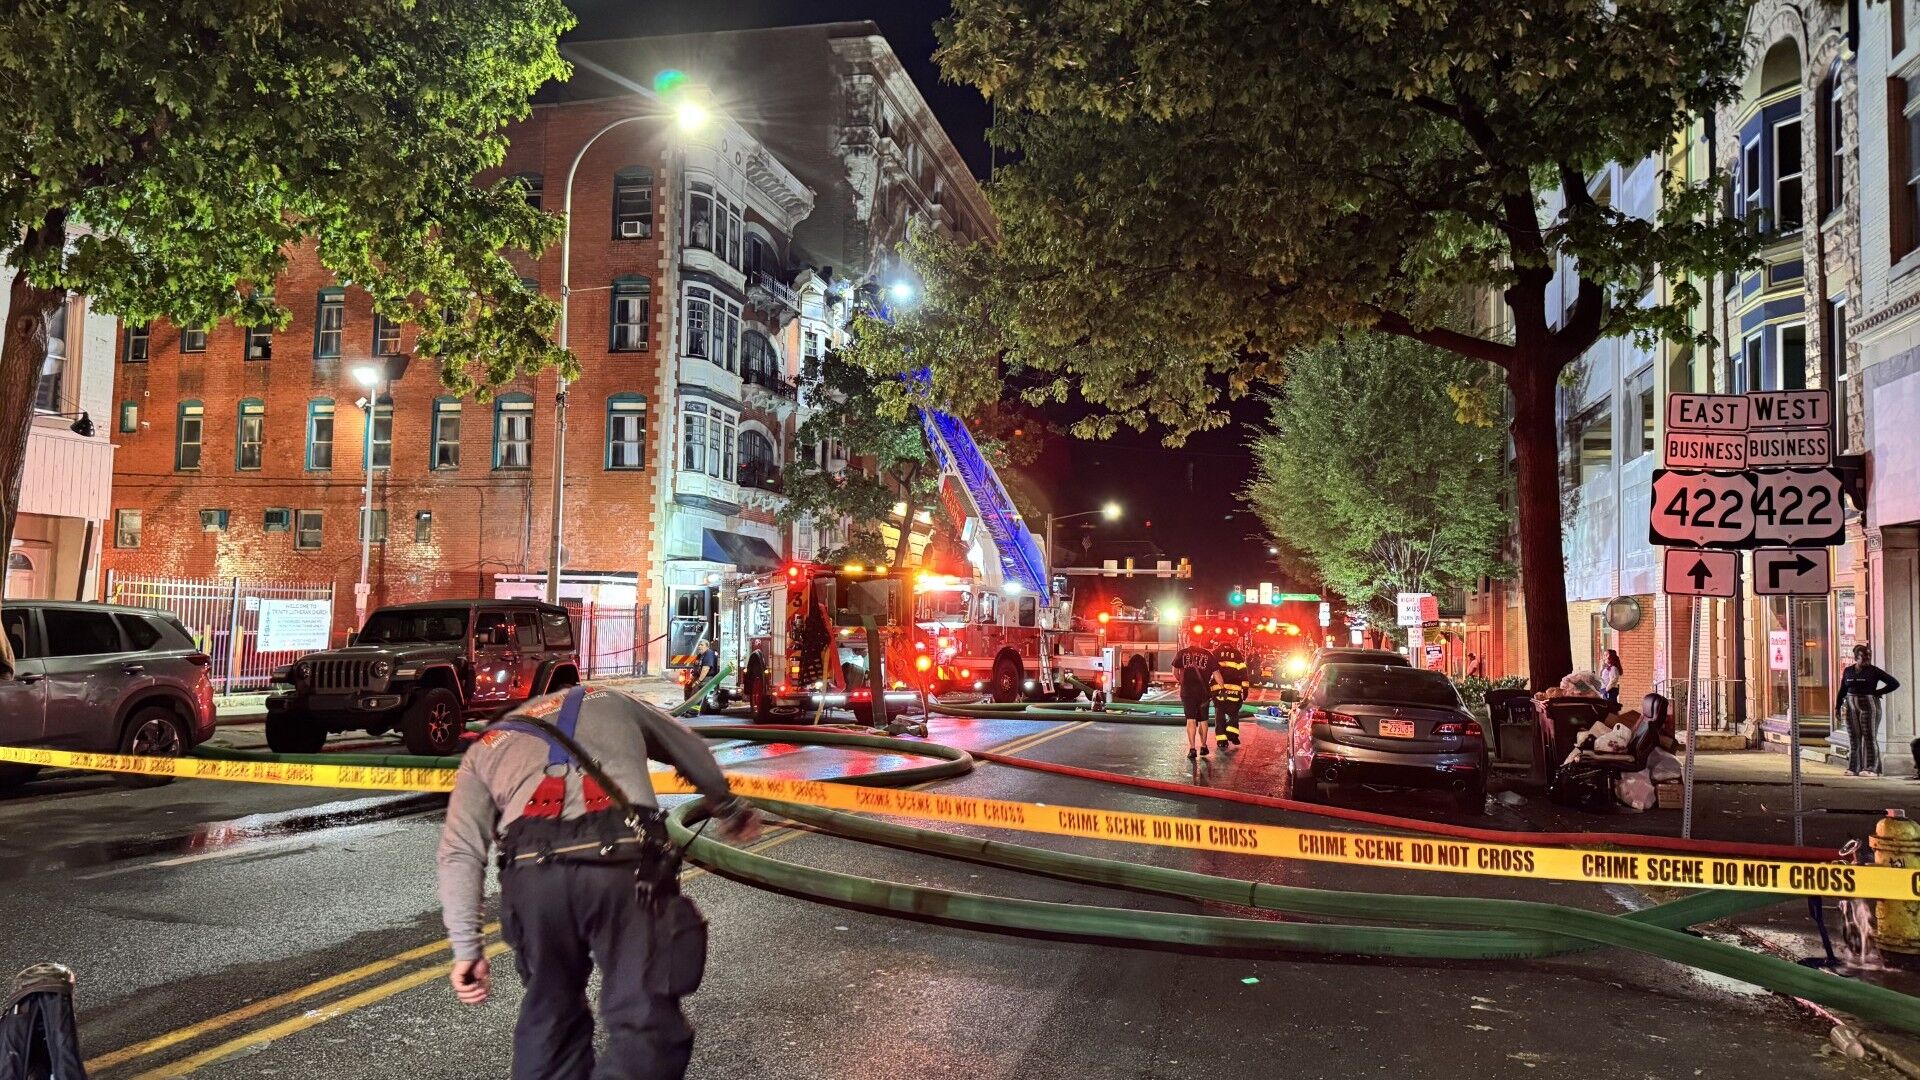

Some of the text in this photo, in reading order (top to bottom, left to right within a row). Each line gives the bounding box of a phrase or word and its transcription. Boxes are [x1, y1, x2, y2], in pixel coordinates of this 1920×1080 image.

[1680, 399, 1738, 424] EAST
[1755, 397, 1820, 421] WEST
[1669, 440, 1743, 461] BUSINESS
[1750, 438, 1826, 457] BUSINESS
[1664, 487, 1744, 529] 422
[1755, 485, 1832, 525] 422
[793, 592, 802, 607] 3
[1058, 811, 1258, 849] CRIME SCENE DO NOT CROSS
[1298, 833, 1535, 872] CRIME SCENE DO NOT CROSS
[1582, 854, 1856, 892] CRIME SCENE DO NOT CROSS
